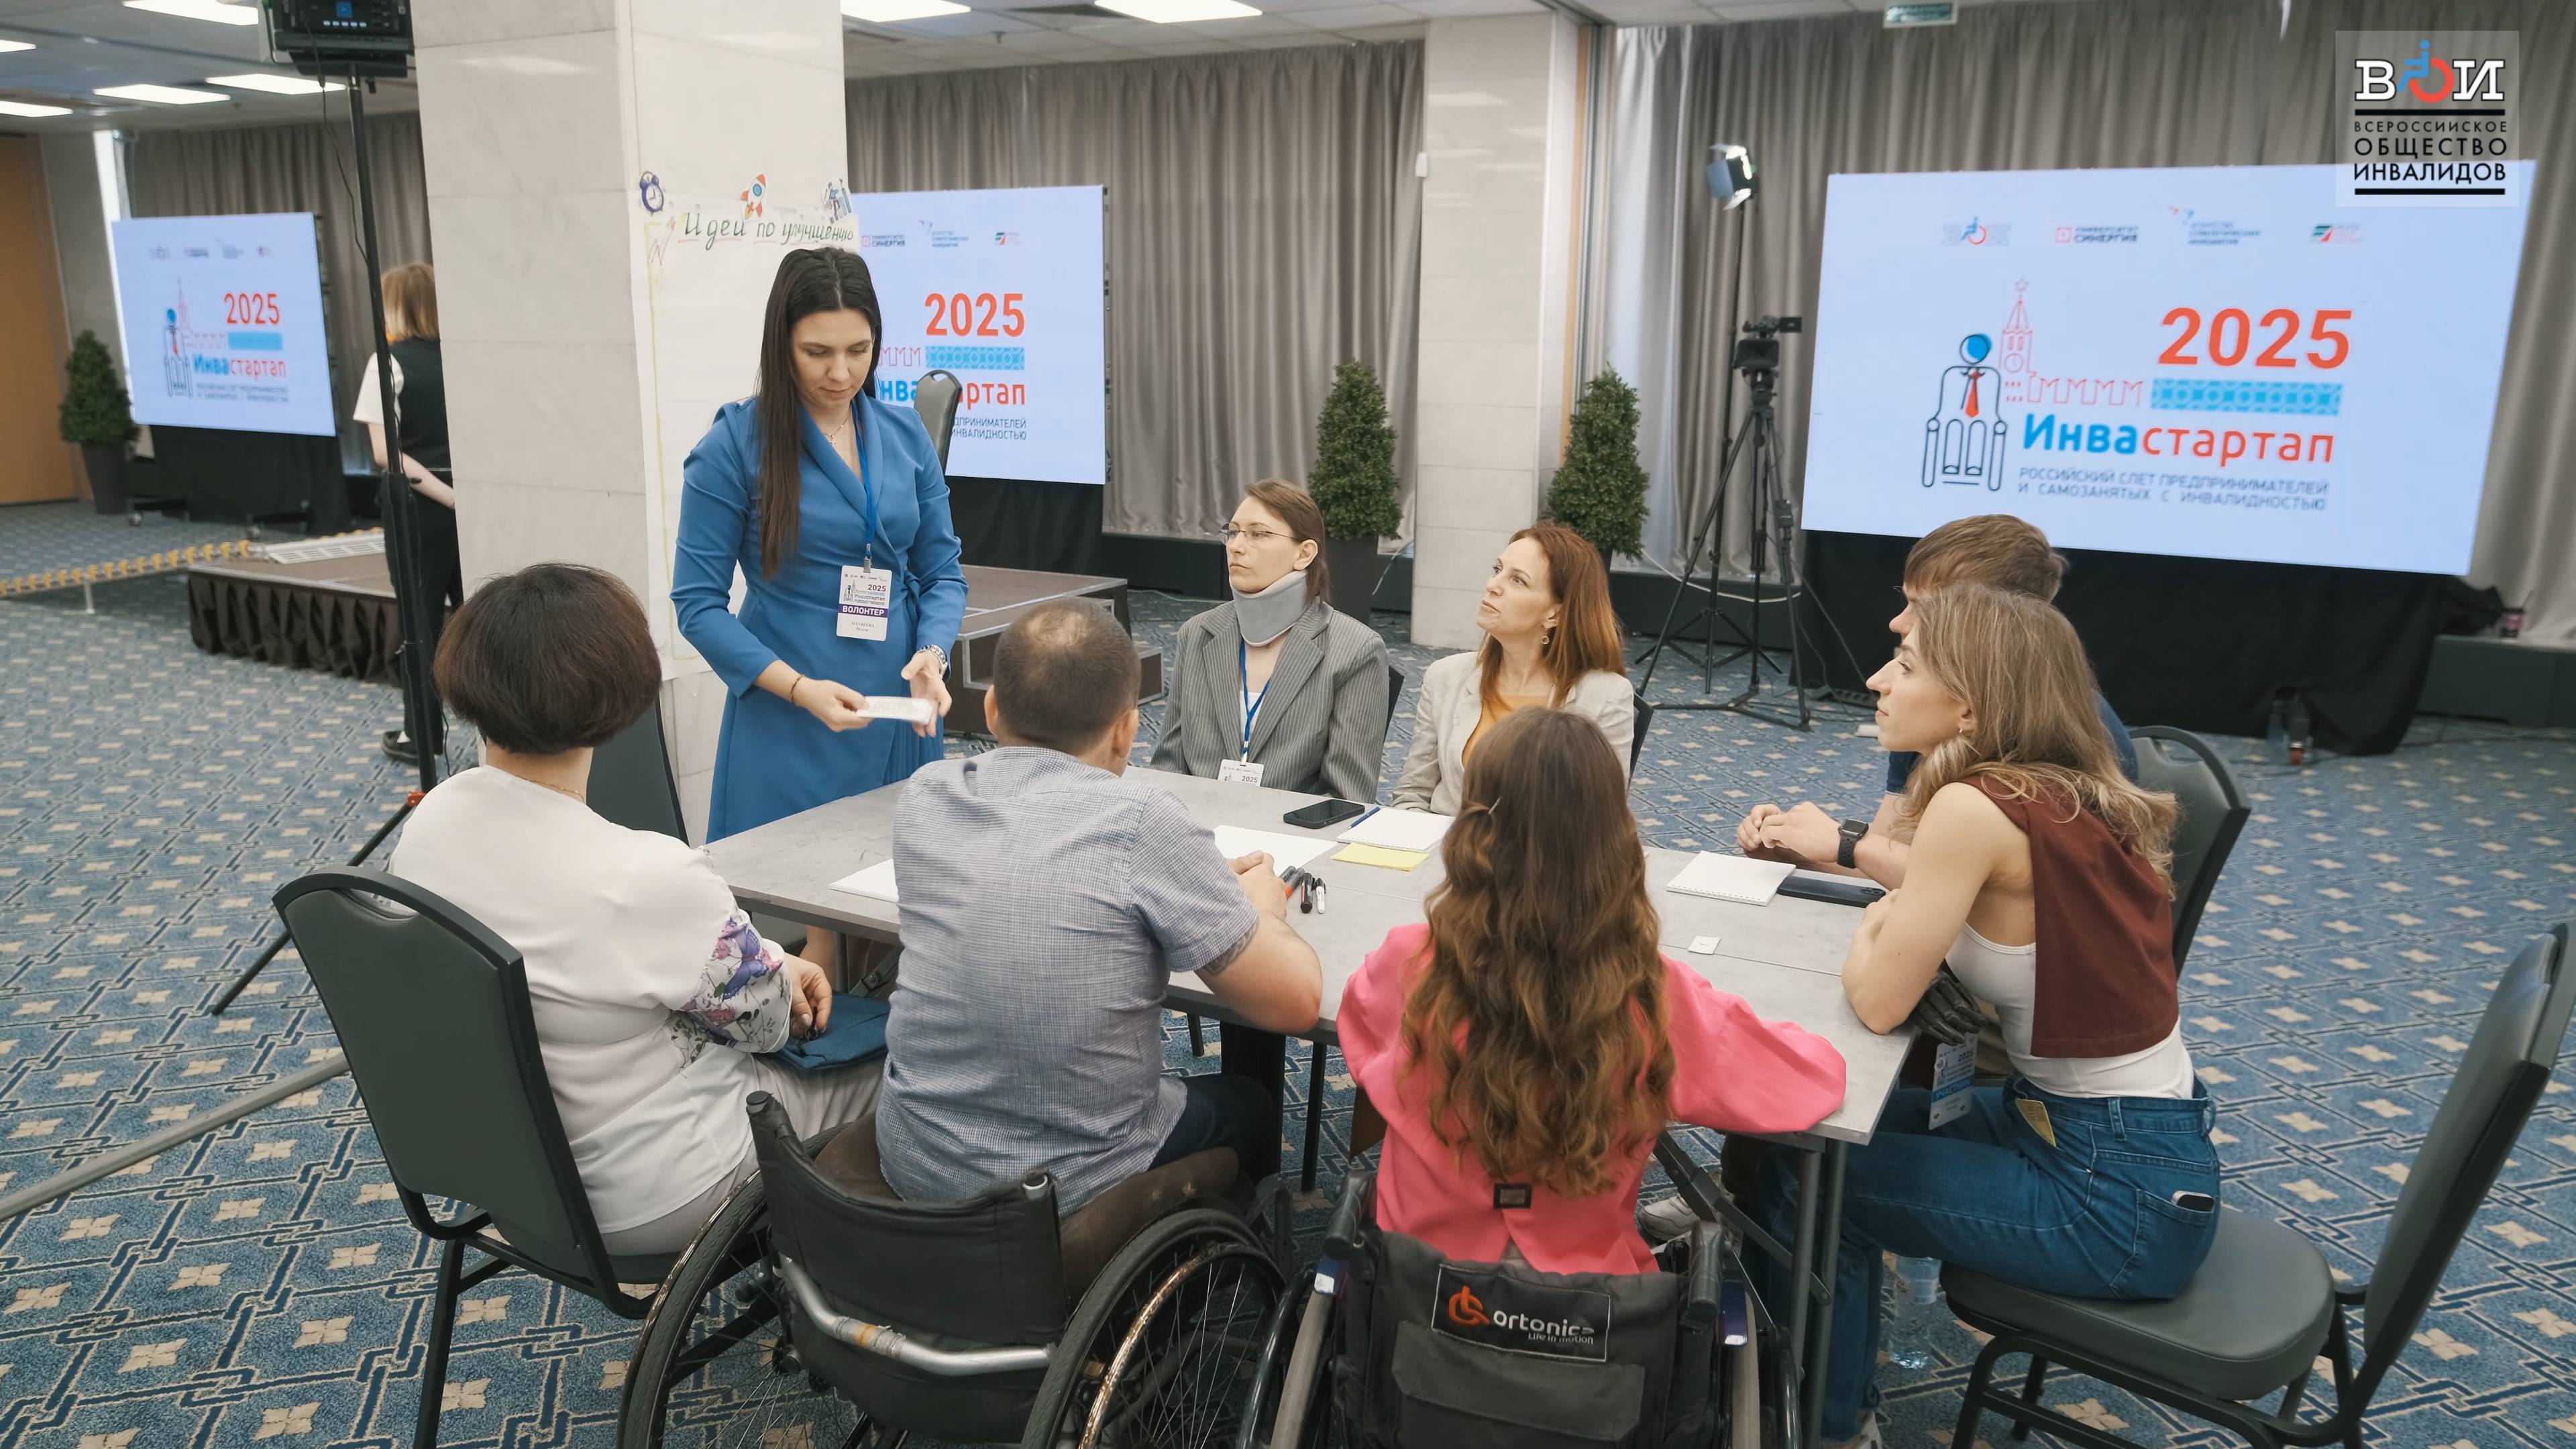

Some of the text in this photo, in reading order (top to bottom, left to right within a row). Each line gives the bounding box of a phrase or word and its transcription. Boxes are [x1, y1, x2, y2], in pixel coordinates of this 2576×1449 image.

[684, 212, 747, 251] Идеи
[757, 221, 775, 237] по
[224, 292, 280, 325] 2025
[924, 292, 1025, 337] 2025
[2158, 307, 2353, 370] 2025
[193, 354, 287, 380] Инвастартап
[954, 417, 1026, 429] ДПРИНИМАТЕЛЕЙ
[2023, 413, 2334, 468] Инвастартап
[2020, 467, 2116, 483] РОССИЙСКИЙ
[2159, 474, 2329, 494] ПРЕДПРИНИМАТЕЛЕЙ
[2018, 482, 2326, 511] И САМОЗАНЯТЫХ С ИНВАЛИДНОСТЬЮ
[867, 584, 887, 592] 2025
[842, 605, 885, 616] ВОЛОНТЕР
